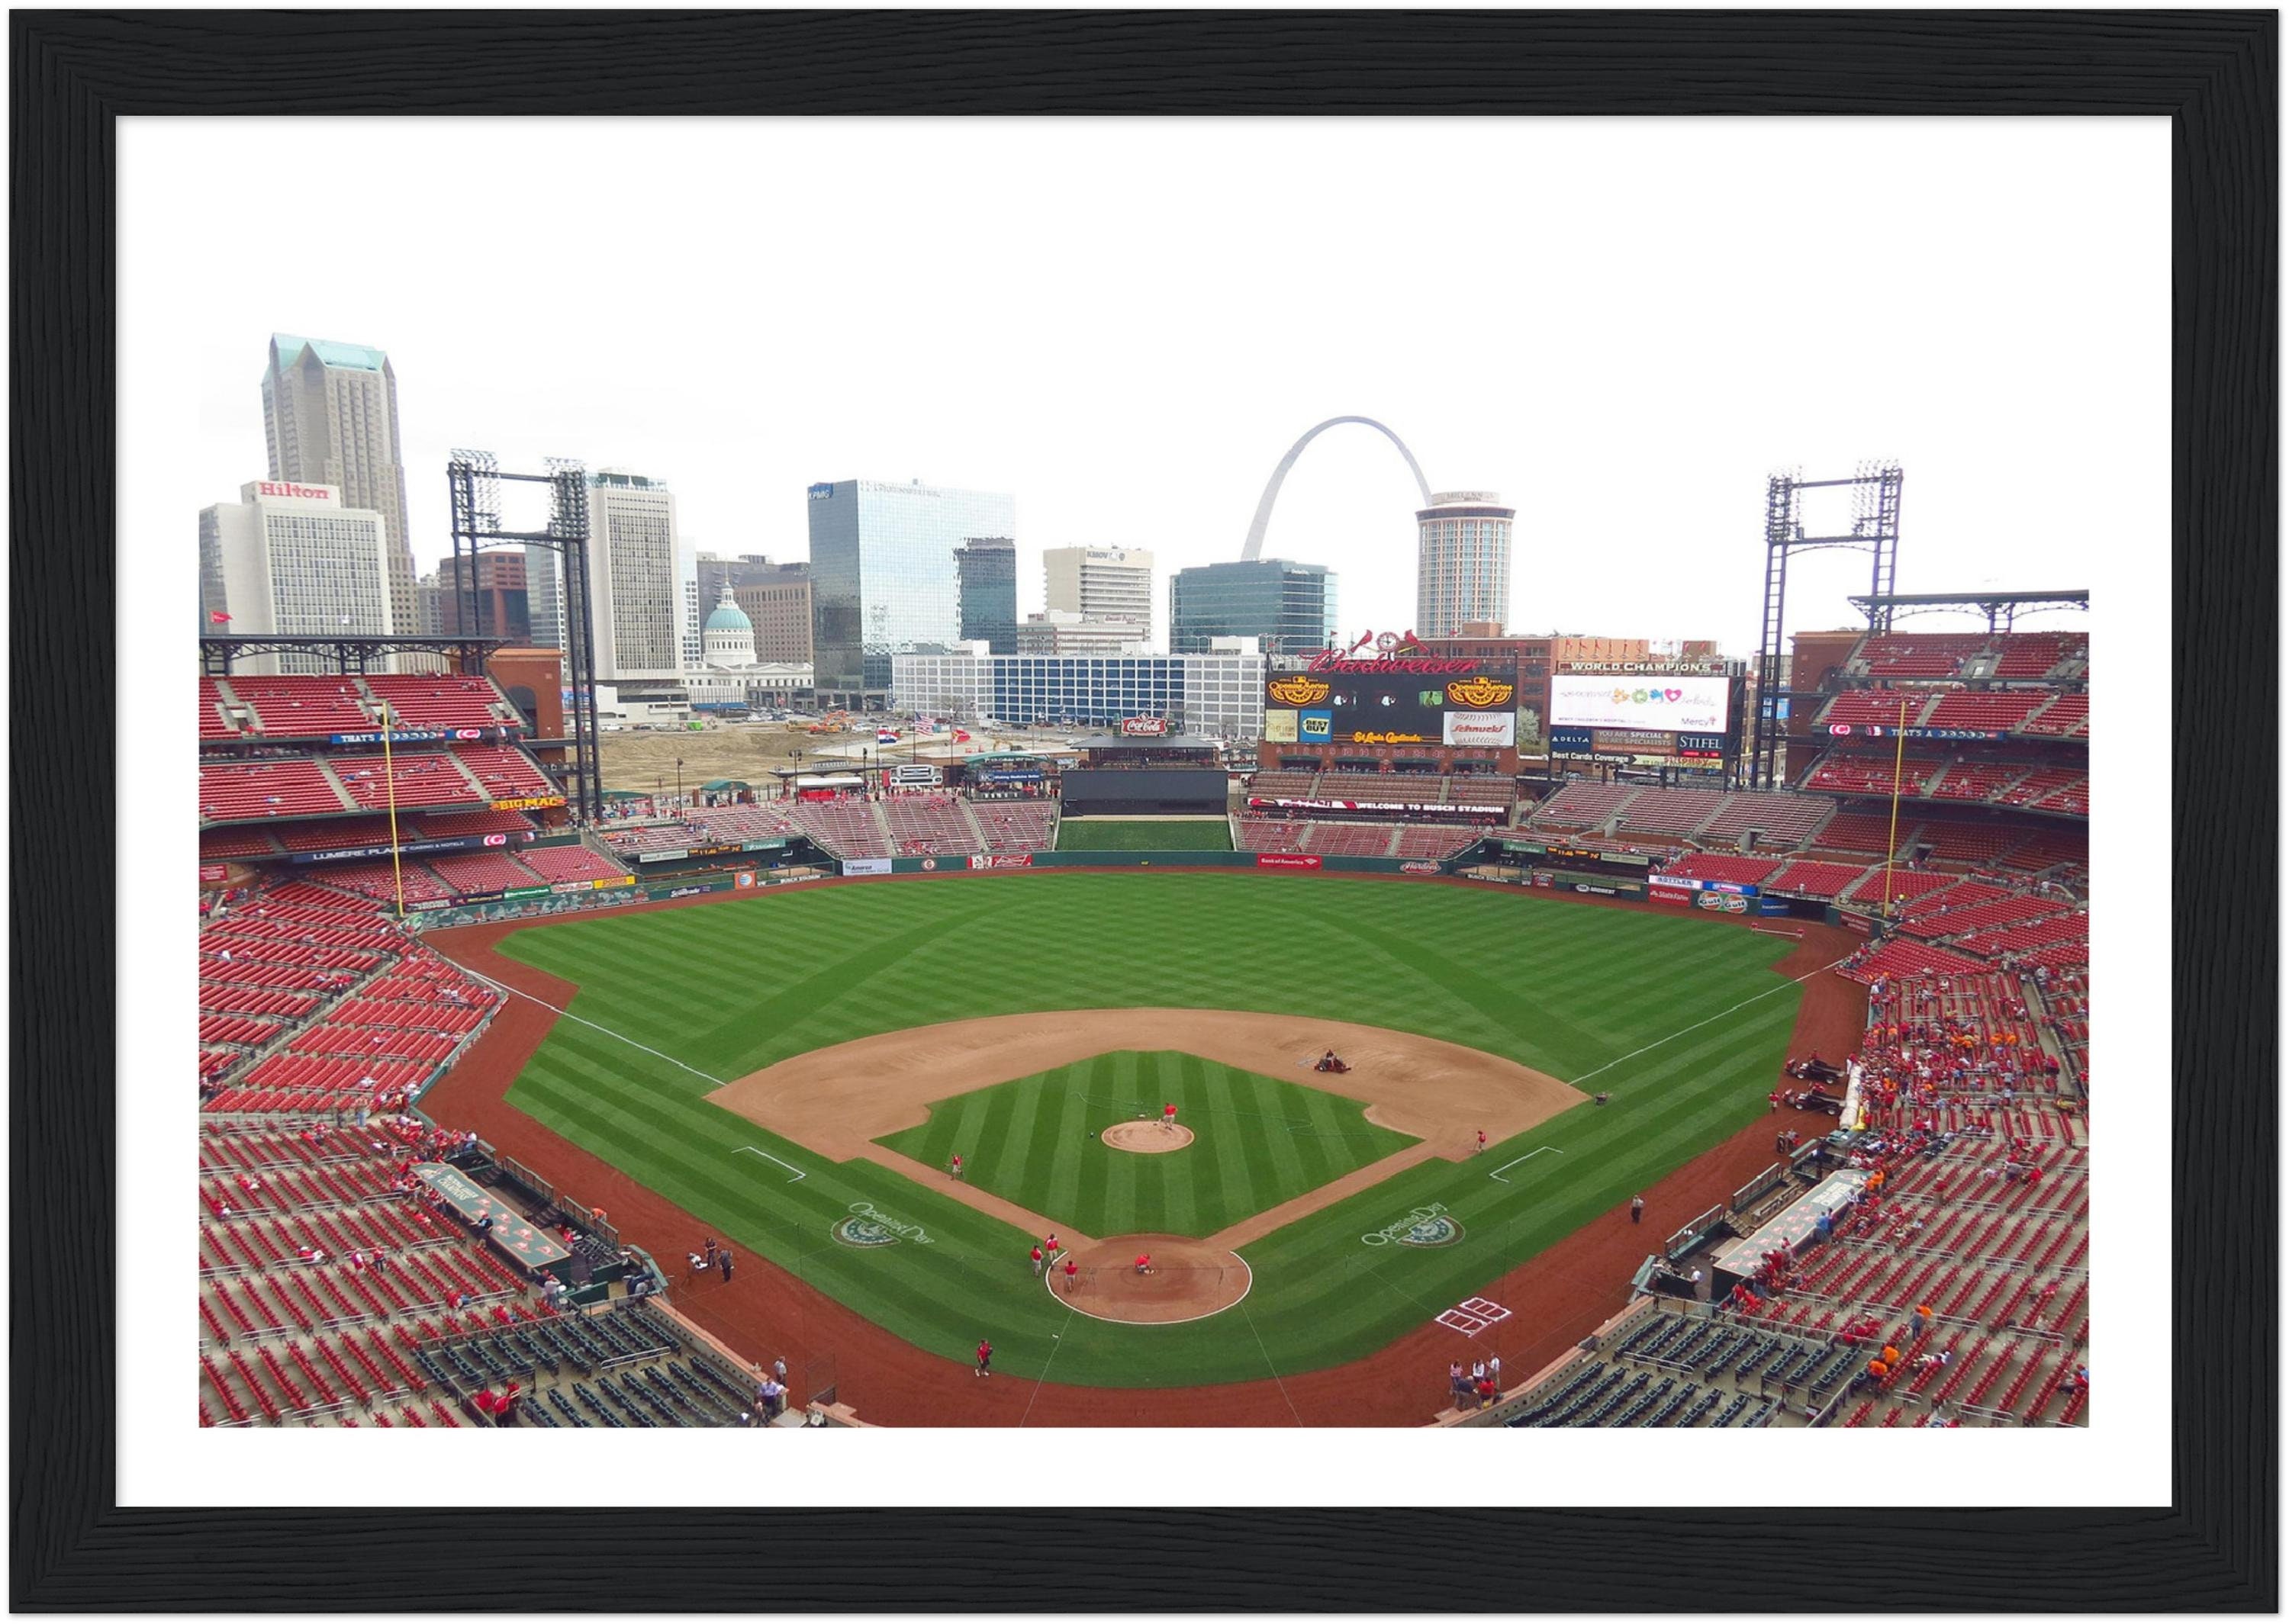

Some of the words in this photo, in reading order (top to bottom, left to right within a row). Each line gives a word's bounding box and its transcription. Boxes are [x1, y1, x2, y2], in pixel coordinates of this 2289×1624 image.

[259, 482, 330, 499] Hilton
[1297, 648, 1480, 674] Budweiser
[1570, 661, 1619, 671] WORLD
[1624, 661, 1711, 671] CHAMPIONS
[1681, 718, 1709, 727] Mercy
[1451, 724, 1506, 733] Schnucks
[341, 733, 375, 742] THAT'S
[1679, 735, 1723, 749] STIFEL
[1552, 751, 1569, 759] Best
[1571, 752, 1592, 761] Cards
[1595, 754, 1628, 764] Coverage
[499, 799, 523, 810] BIG
[524, 798, 558, 807] MAC
[1699, 897, 1721, 905] Gulf
[1724, 901, 1746, 909] Gulf
